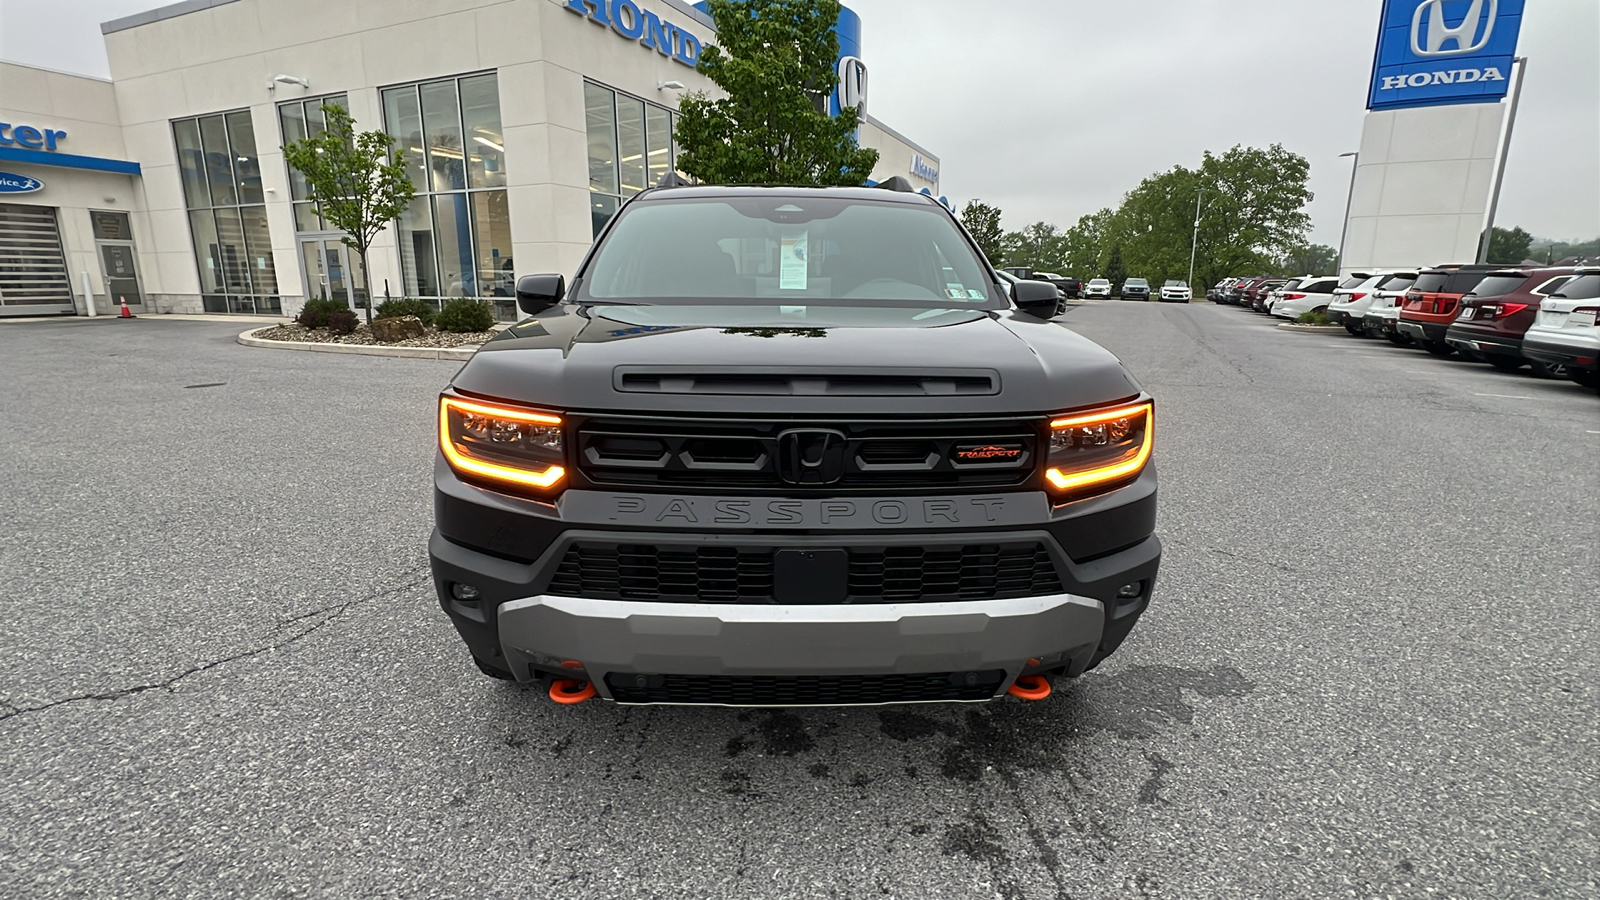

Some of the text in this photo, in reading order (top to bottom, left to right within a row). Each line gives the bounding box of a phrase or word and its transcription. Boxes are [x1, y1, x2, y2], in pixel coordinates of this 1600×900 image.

[1380, 67, 1505, 90] HONDA
[958, 450, 1021, 459] TRAILSPORT
[609, 496, 1005, 525] PASSPORT
